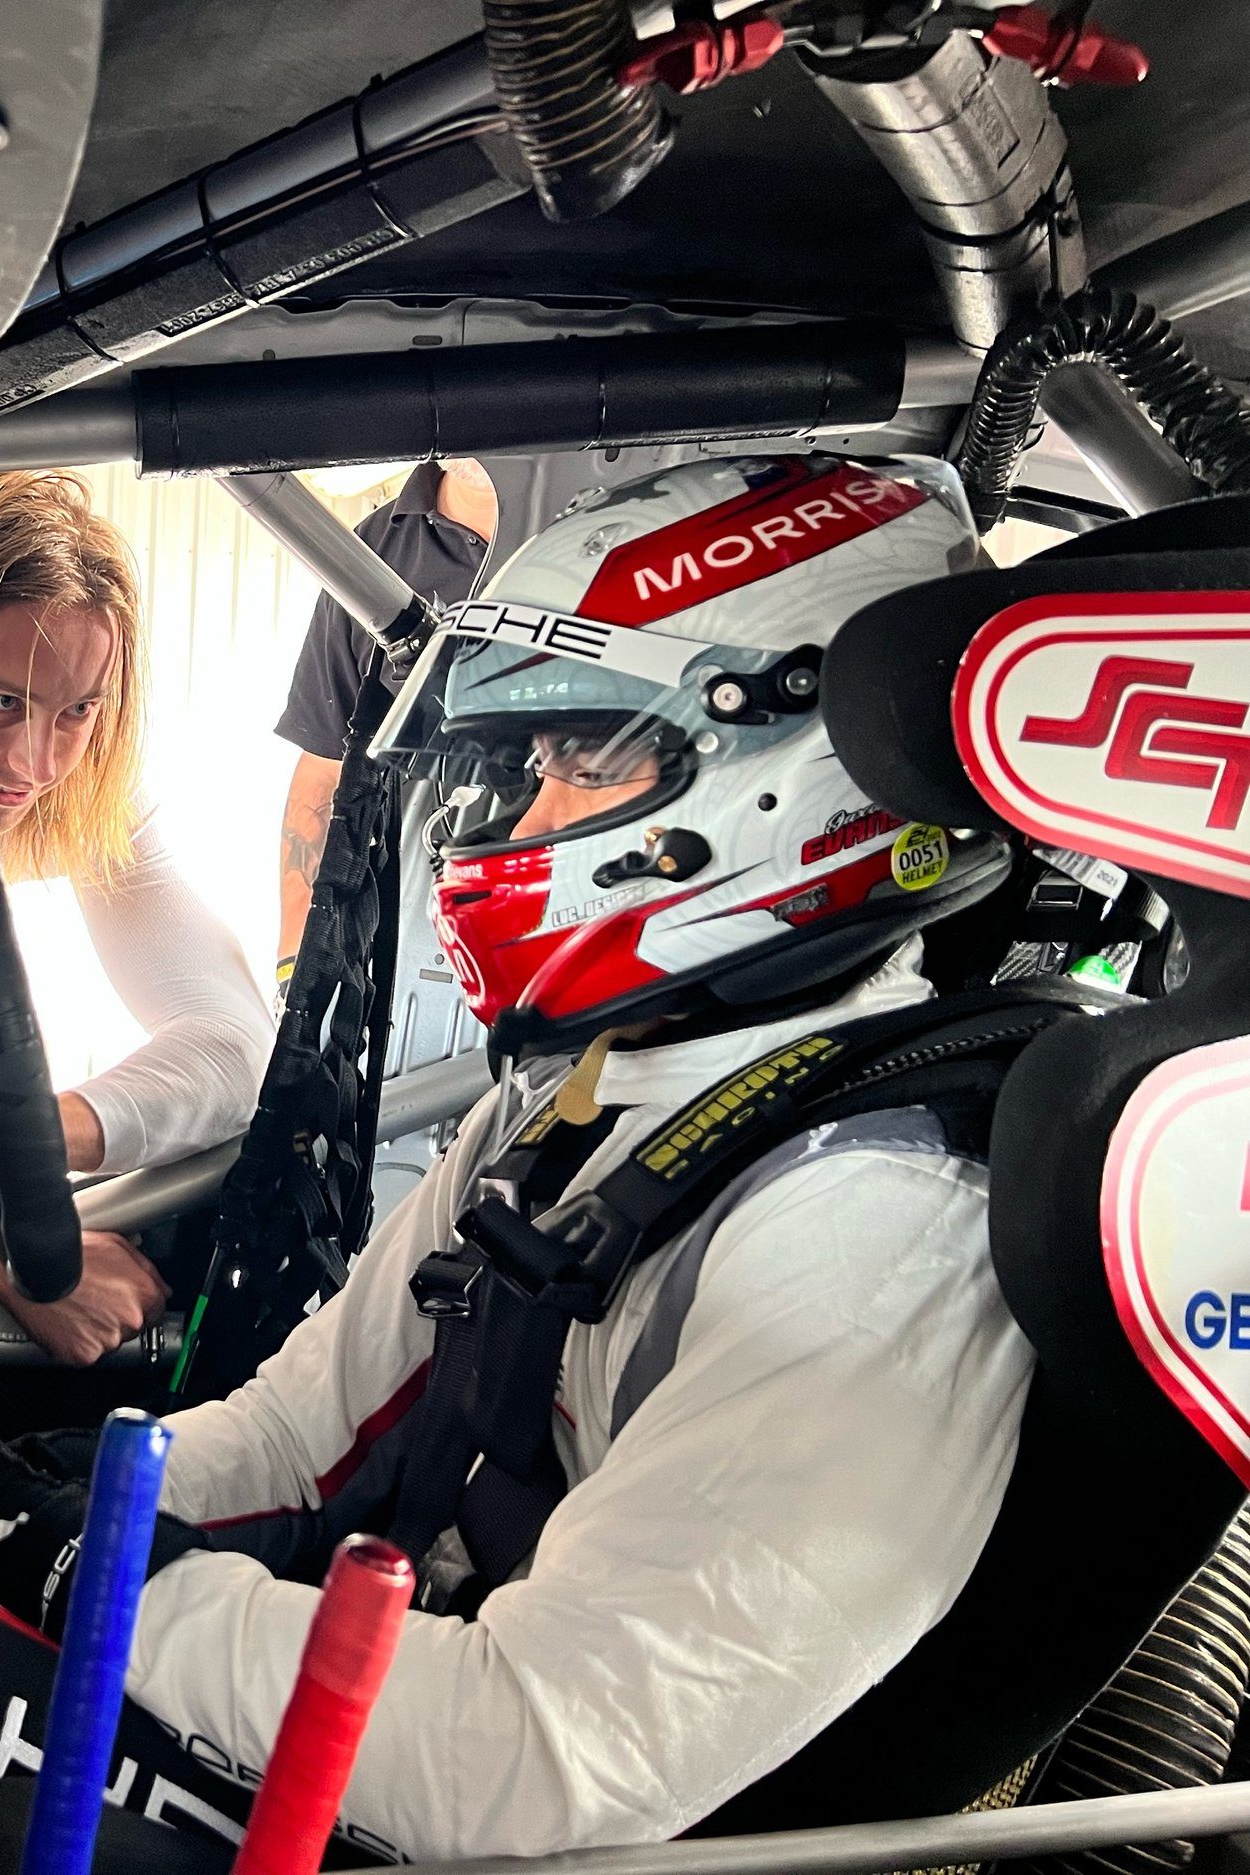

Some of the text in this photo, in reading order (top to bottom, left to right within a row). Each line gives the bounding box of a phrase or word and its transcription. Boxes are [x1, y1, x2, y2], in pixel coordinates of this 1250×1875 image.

[633, 475, 886, 600] MORRIS
[899, 840, 943, 871] 0051
[902, 862, 943, 884] HELMET
[1096, 870, 1119, 887] 2021
